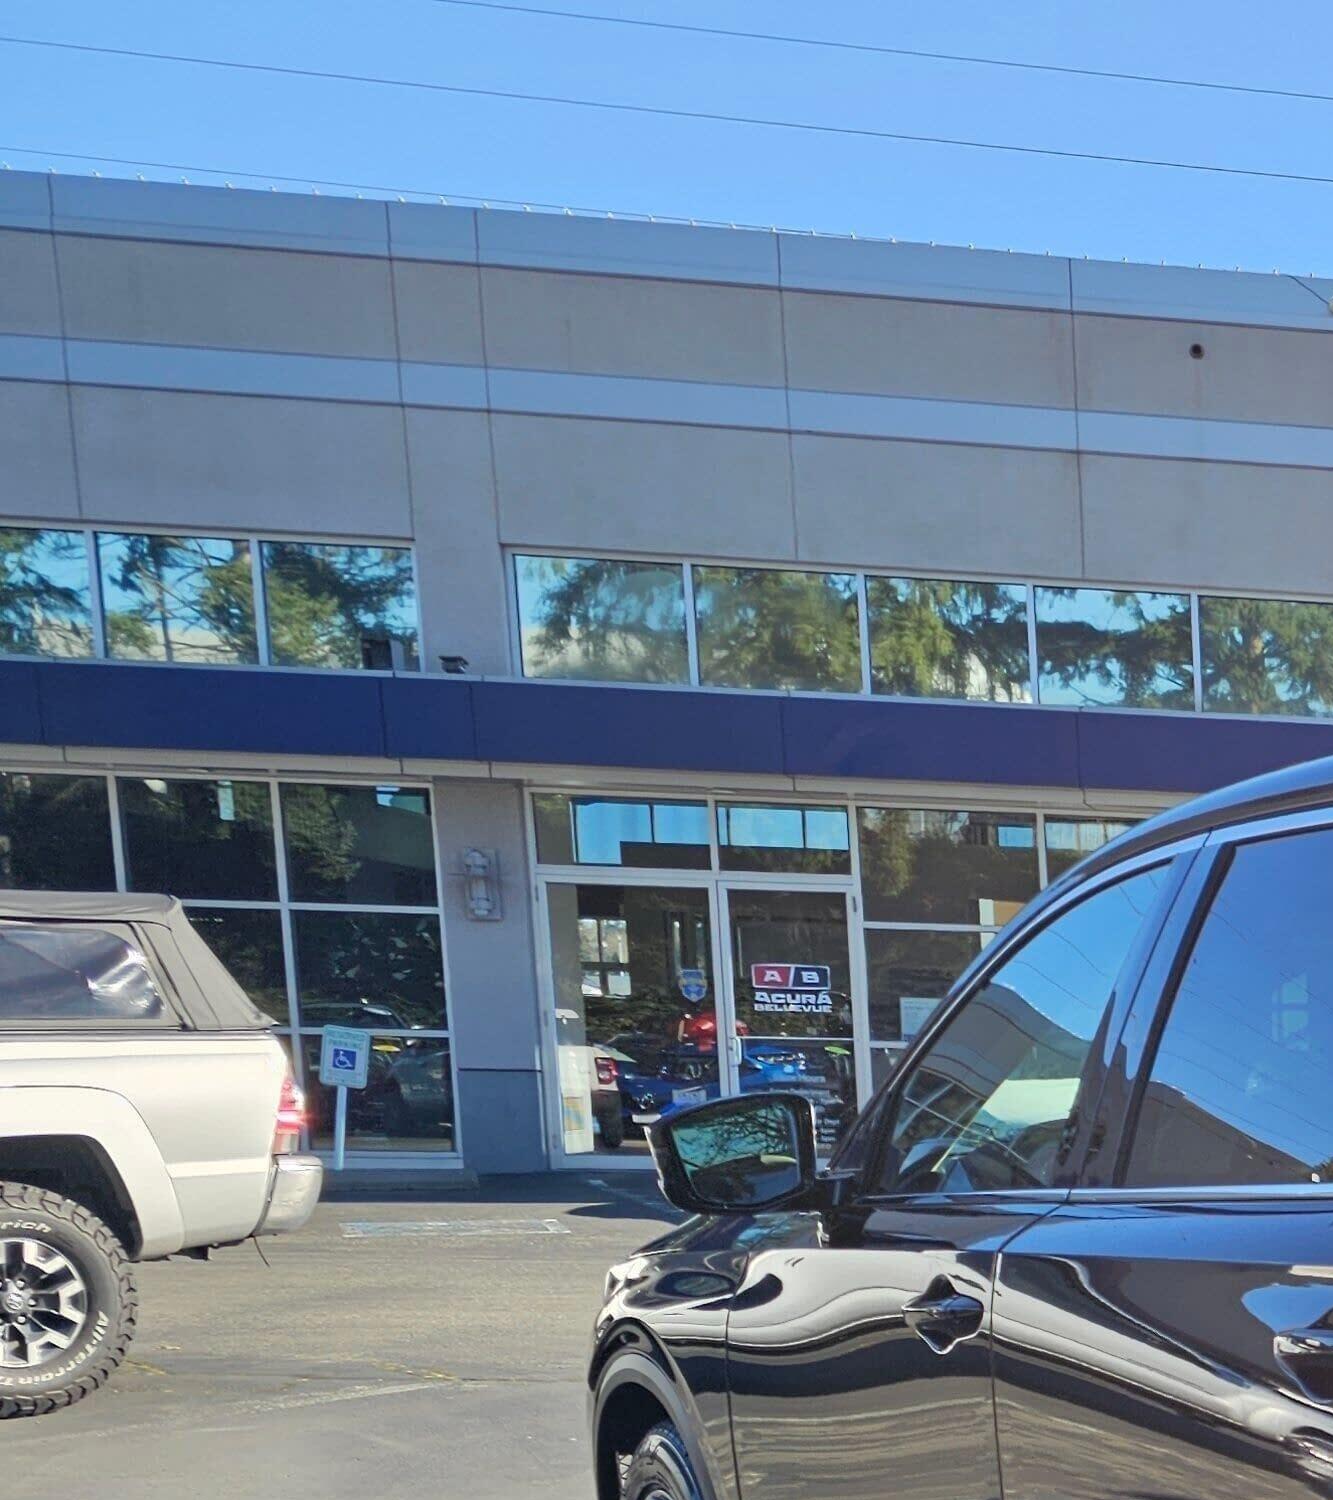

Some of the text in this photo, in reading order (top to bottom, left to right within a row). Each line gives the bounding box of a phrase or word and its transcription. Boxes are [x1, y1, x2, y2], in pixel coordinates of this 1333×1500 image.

[763, 970, 820, 983] A B
[754, 991, 833, 1004] ACURA
[754, 1003, 833, 1013] BELLEVUE
